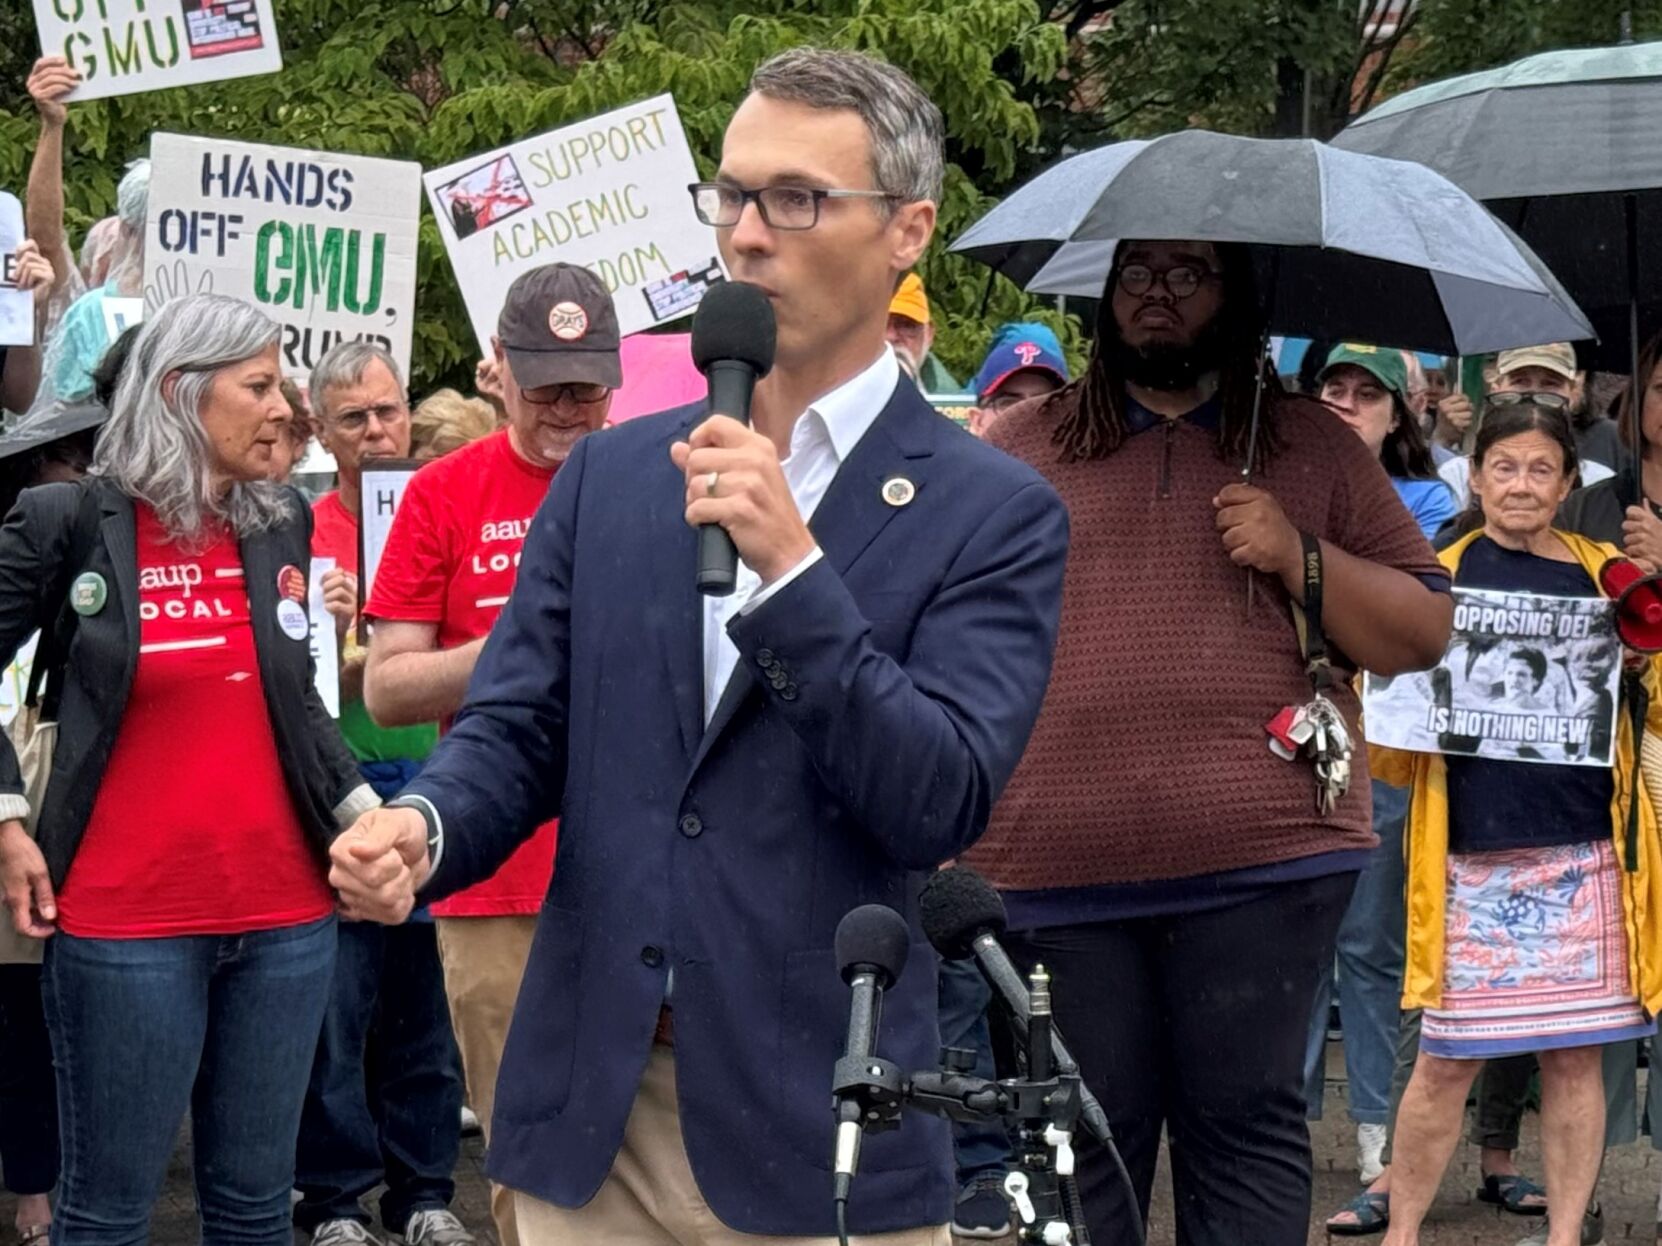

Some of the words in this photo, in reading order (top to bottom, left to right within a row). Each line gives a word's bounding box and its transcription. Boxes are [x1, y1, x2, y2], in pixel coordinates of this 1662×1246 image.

[64, 16, 179, 81] GMU
[528, 108, 667, 189] SUPPORT
[202, 152, 354, 212] HANDS
[159, 208, 243, 257] OFF
[493, 184, 649, 266] ACADEMIC
[481, 517, 531, 543] aau
[139, 563, 202, 598] aup
[140, 598, 233, 620] OCAL
[1453, 604, 1552, 637] OPPOSING
[1557, 612, 1590, 639] DEI
[1428, 706, 1449, 734] IS
[1451, 709, 1538, 742] NOTHING
[1542, 715, 1590, 744] NEW
